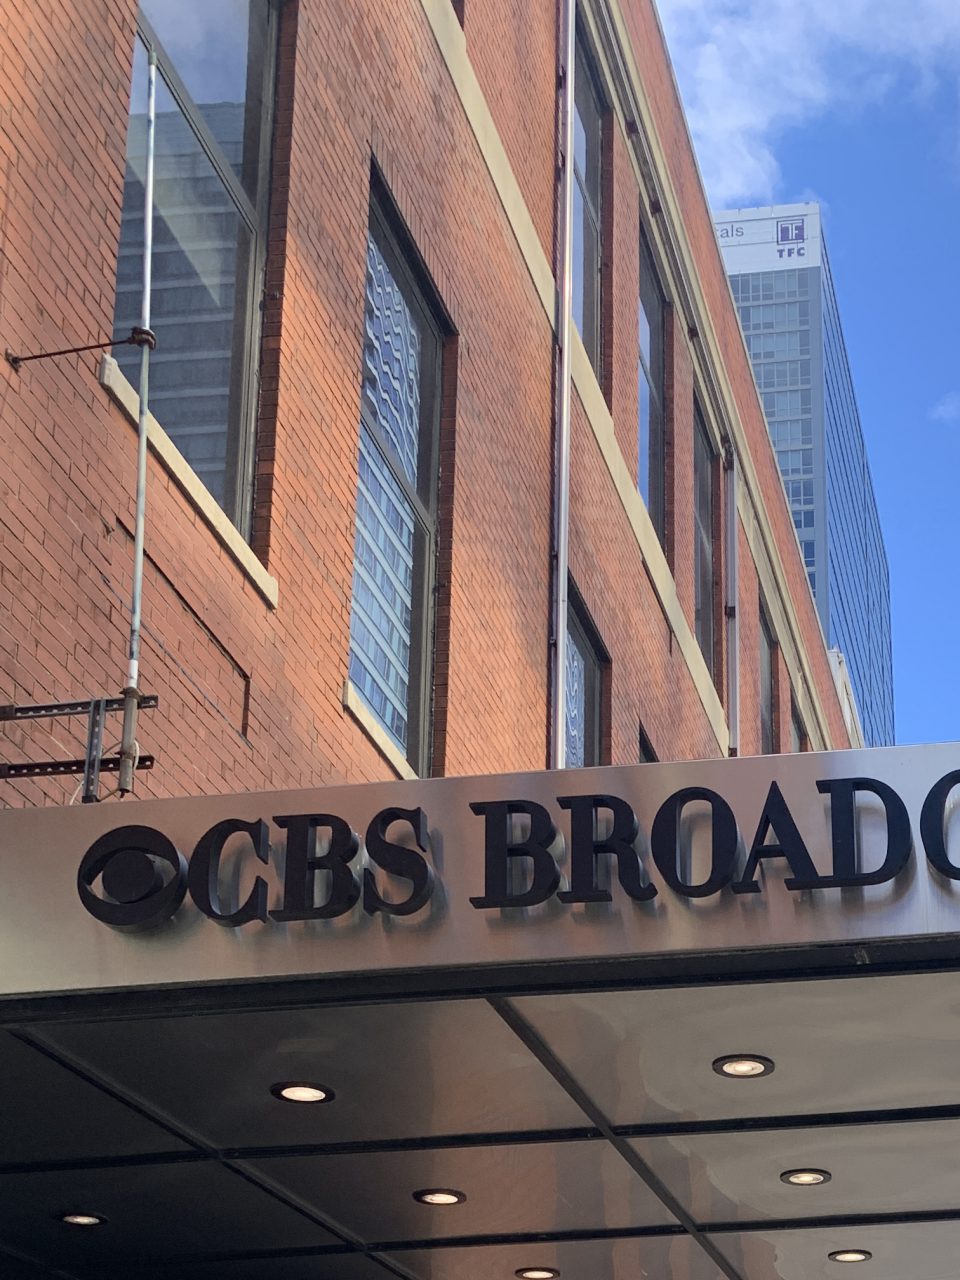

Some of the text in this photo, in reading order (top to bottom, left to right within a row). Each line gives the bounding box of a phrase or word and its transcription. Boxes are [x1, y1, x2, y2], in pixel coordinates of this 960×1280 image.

[716, 224, 745, 238] als
[777, 247, 806, 258] TFC
[187, 806, 436, 928] CBS
